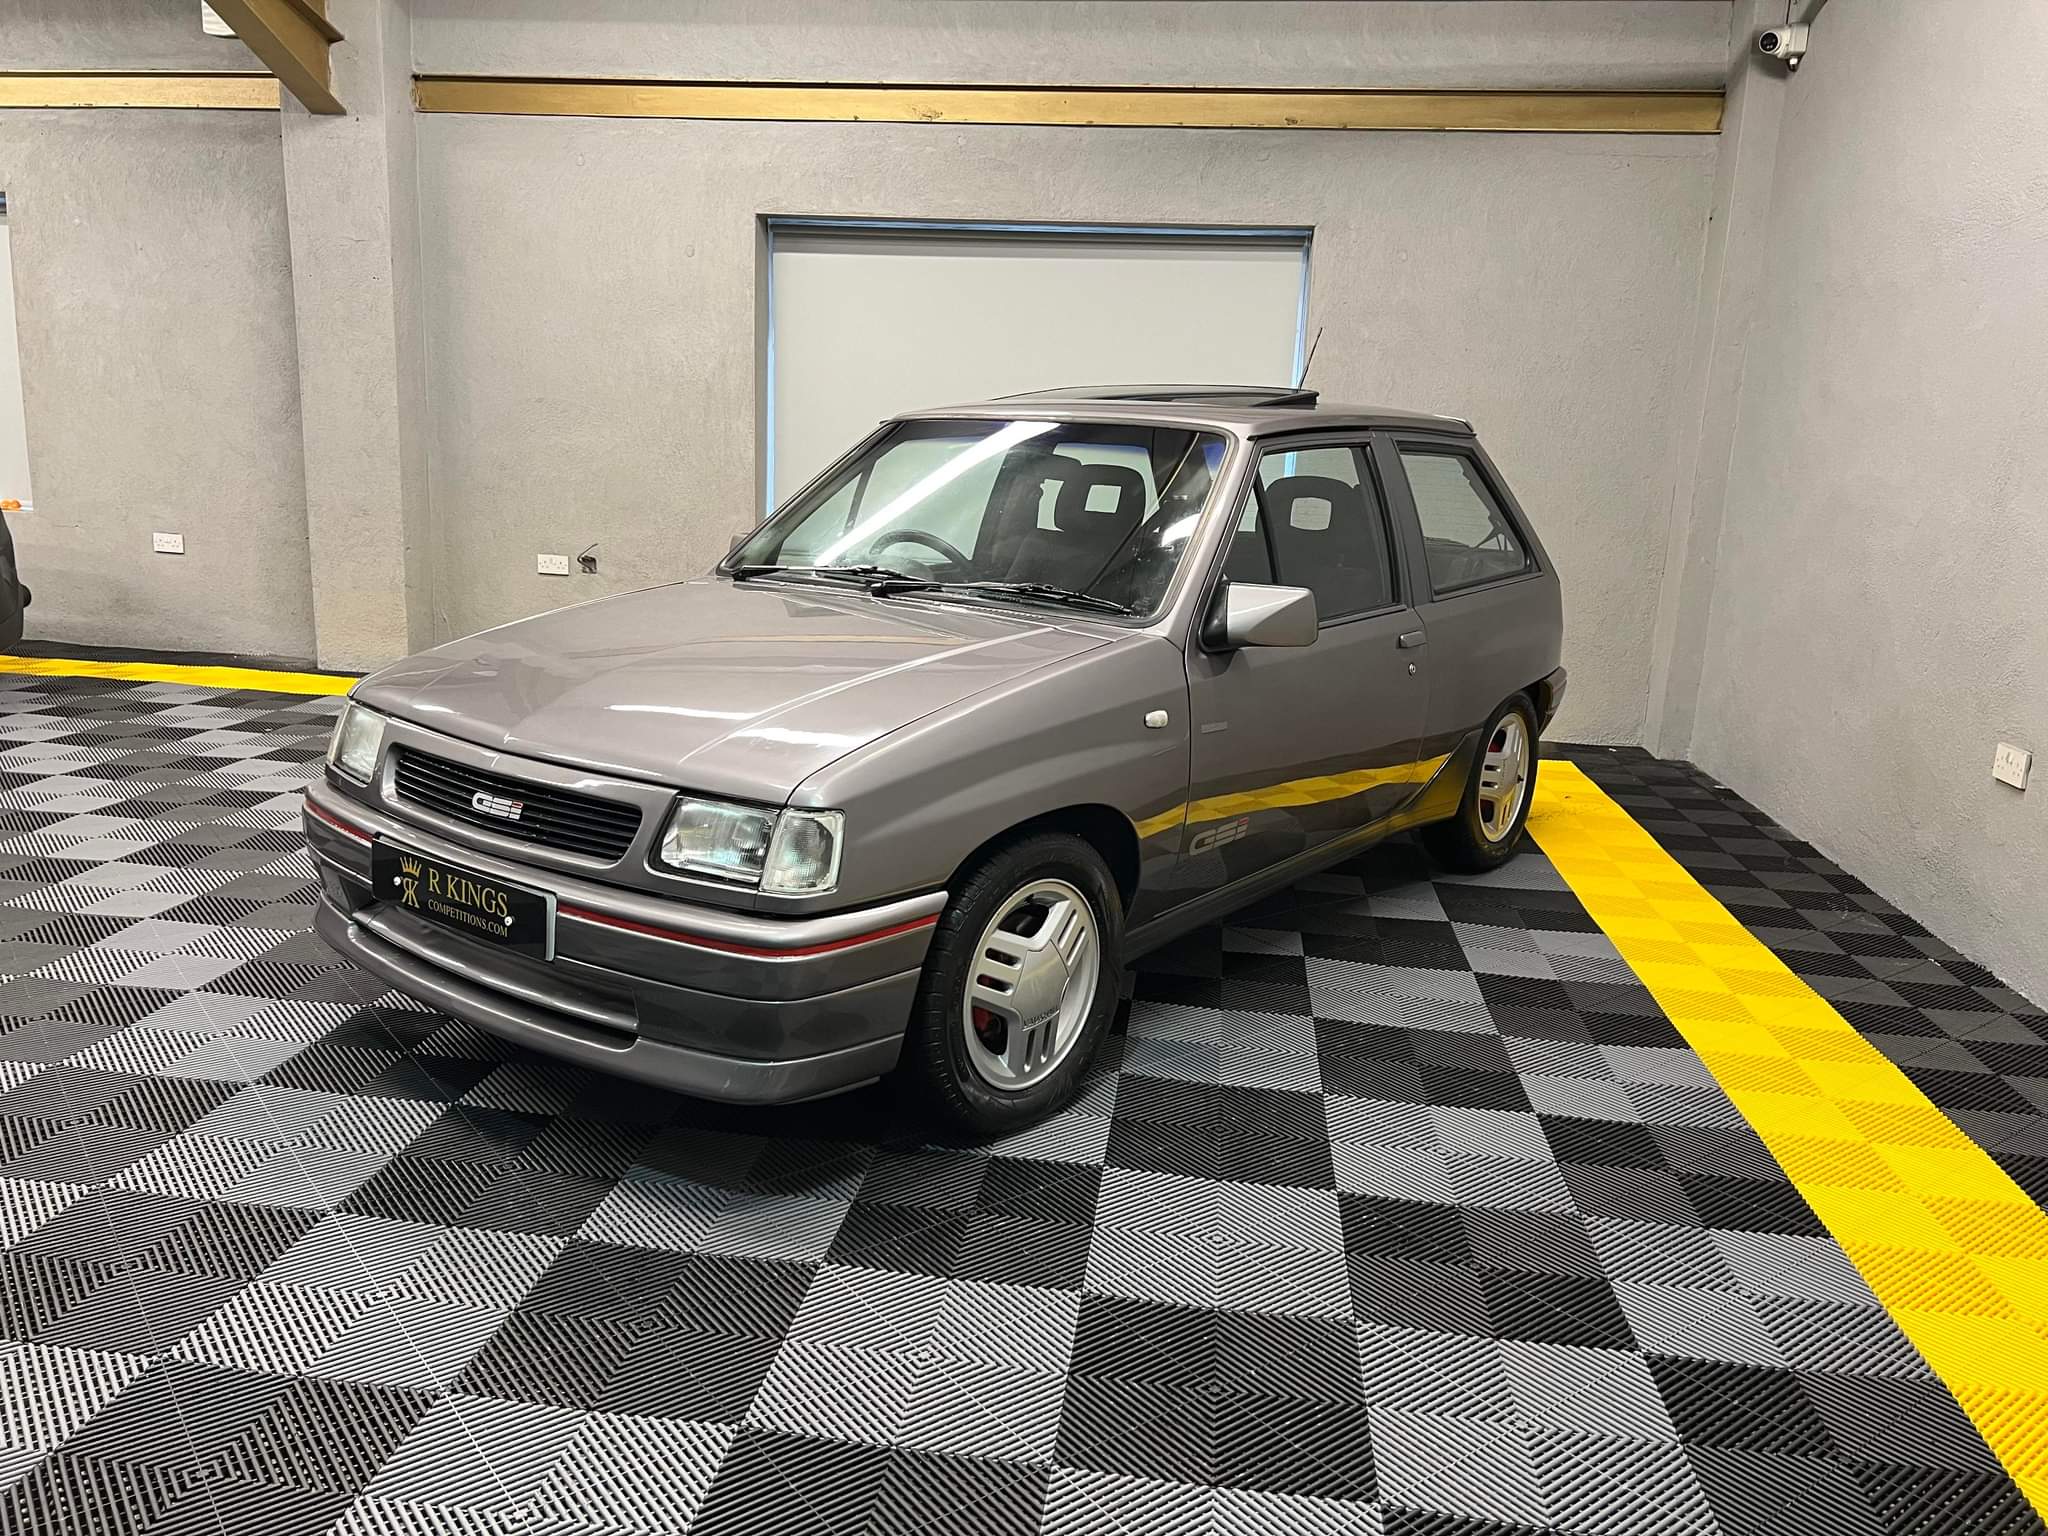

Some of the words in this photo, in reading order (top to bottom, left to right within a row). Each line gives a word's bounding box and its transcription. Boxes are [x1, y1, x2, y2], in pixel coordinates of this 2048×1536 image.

[428, 868, 442, 895] R
[446, 874, 508, 918] KINGS
[428, 899, 508, 938] COMPETITIONS.COM
